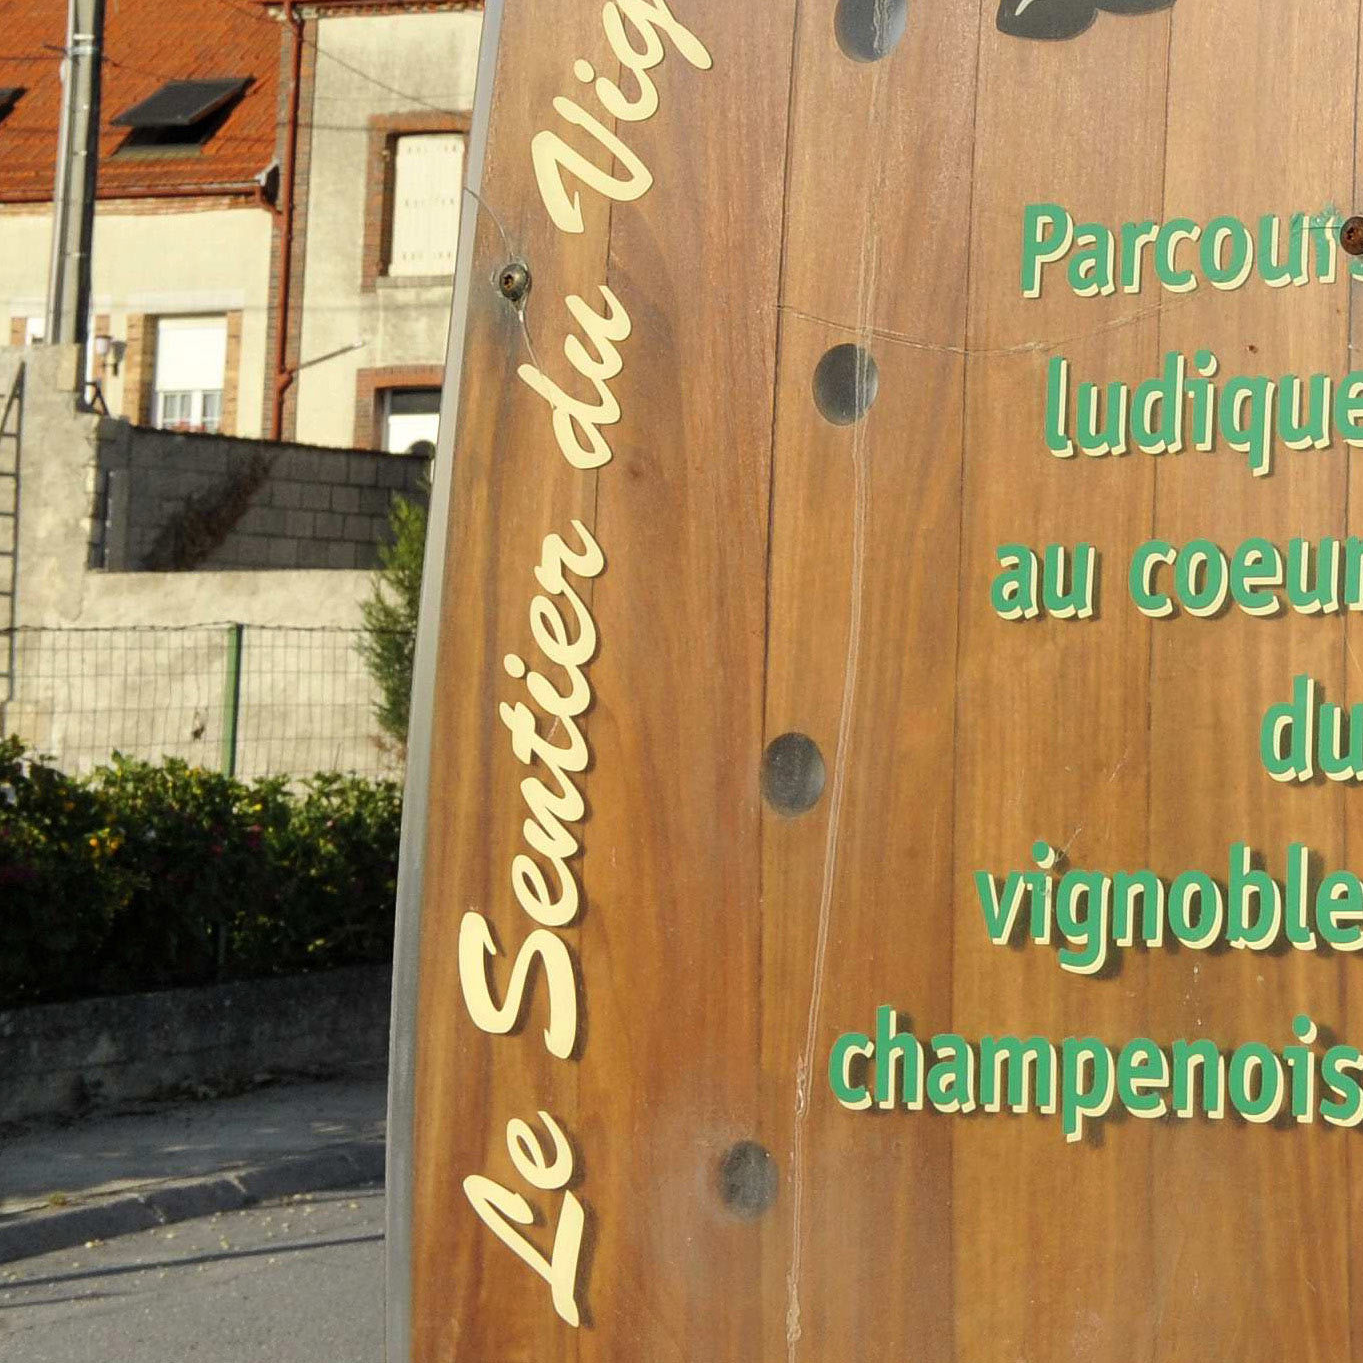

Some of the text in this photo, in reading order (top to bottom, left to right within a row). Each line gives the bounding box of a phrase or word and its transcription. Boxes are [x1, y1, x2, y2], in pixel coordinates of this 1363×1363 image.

[519, 285, 634, 470] du
[990, 542, 1097, 620] au
[458, 519, 606, 1061] Sentier
[463, 1109, 586, 1328] Le
